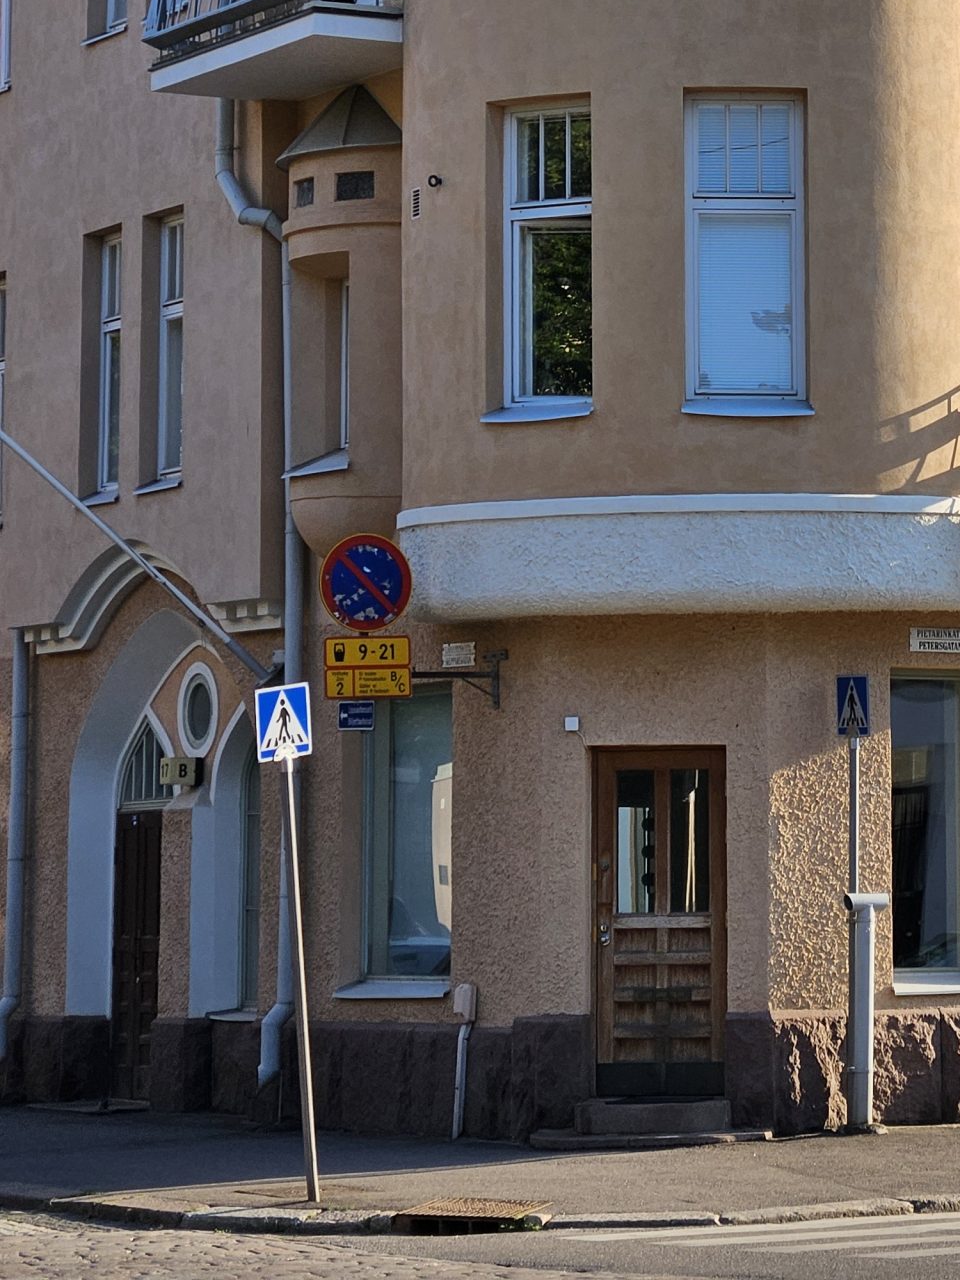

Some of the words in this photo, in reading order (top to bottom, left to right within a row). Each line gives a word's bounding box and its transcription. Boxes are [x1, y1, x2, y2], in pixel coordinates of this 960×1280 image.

[336, 682, 344, 695] 2
[161, 763, 169, 778] 17
[179, 763, 187, 778] B
